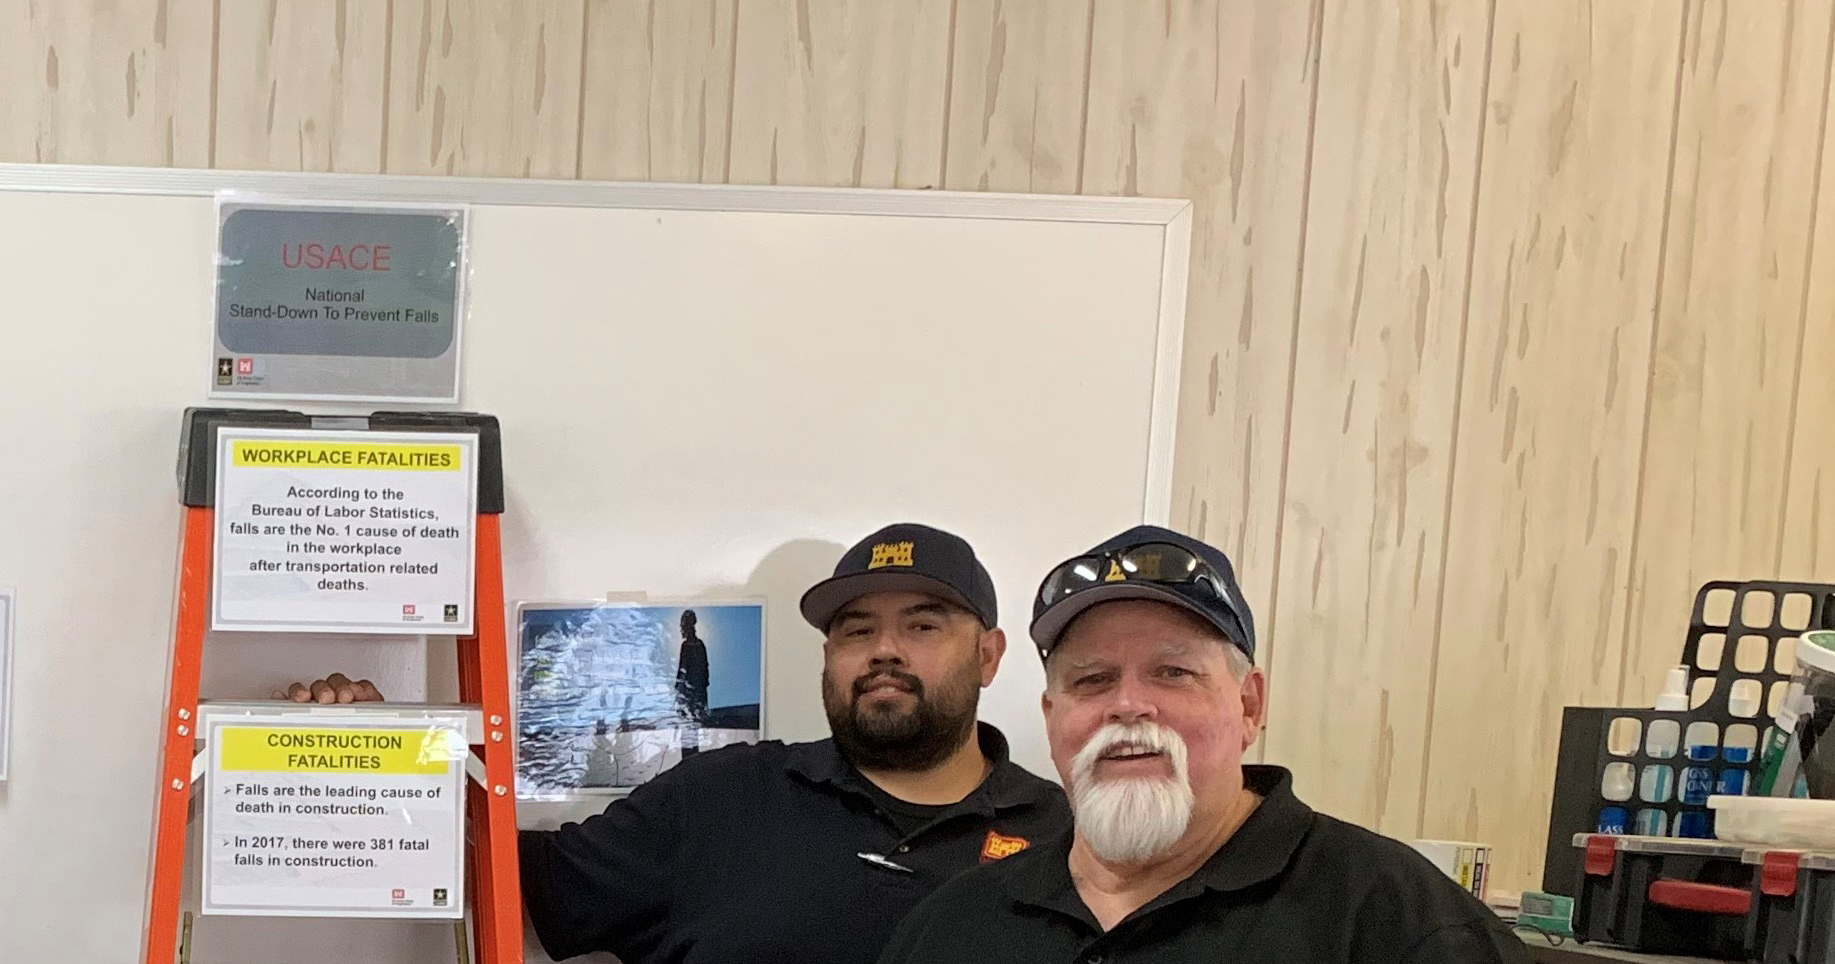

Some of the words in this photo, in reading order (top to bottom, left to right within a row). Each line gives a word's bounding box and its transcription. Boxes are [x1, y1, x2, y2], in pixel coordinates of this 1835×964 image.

[282, 244, 391, 270] USACE
[305, 288, 365, 302] National
[229, 304, 318, 319] Stand-Down
[323, 306, 340, 320] To
[344, 307, 400, 321] Prevent
[405, 308, 439, 323] Falls
[242, 449, 352, 464] WORKPLACE
[357, 451, 451, 466] FATALITIES
[287, 486, 360, 502] According
[364, 488, 378, 500] to
[382, 488, 404, 500] the
[252, 504, 302, 516] Bureau
[306, 505, 321, 517] of
[324, 506, 366, 518] Labor
[369, 506, 439, 520] Statistics,
[230, 522, 259, 534] falls
[263, 525, 286, 535] are
[290, 524, 312, 536] the
[316, 524, 339, 536] No.
[345, 524, 350, 536] 1
[356, 527, 398, 537] cause
[402, 526, 417, 537] of
[420, 526, 459, 538] death
[287, 542, 299, 553] in
[303, 542, 326, 553] the
[330, 543, 402, 555] workplace
[249, 559, 282, 571] after
[285, 561, 385, 574] transportation
[390, 563, 438, 574] related
[317, 578, 368, 591] deaths.
[267, 734, 402, 749] CONSTRUCTION
[288, 754, 381, 769] FATALITIES
[236, 783, 269, 796] Falls
[273, 787, 295, 796] are
[299, 785, 321, 797] the
[325, 786, 377, 799] leading
[380, 789, 423, 798] cause
[426, 787, 441, 798] of
[235, 801, 274, 813] death
[278, 804, 291, 813] in
[295, 804, 388, 815] construction.
[235, 836, 247, 847] In
[292, 838, 328, 849] there
[332, 840, 366, 850] were
[370, 839, 393, 850] 381
[399, 839, 429, 851] fatal
[234, 853, 263, 865] falls
[268, 855, 281, 866] in
[284, 856, 378, 867] construction.
